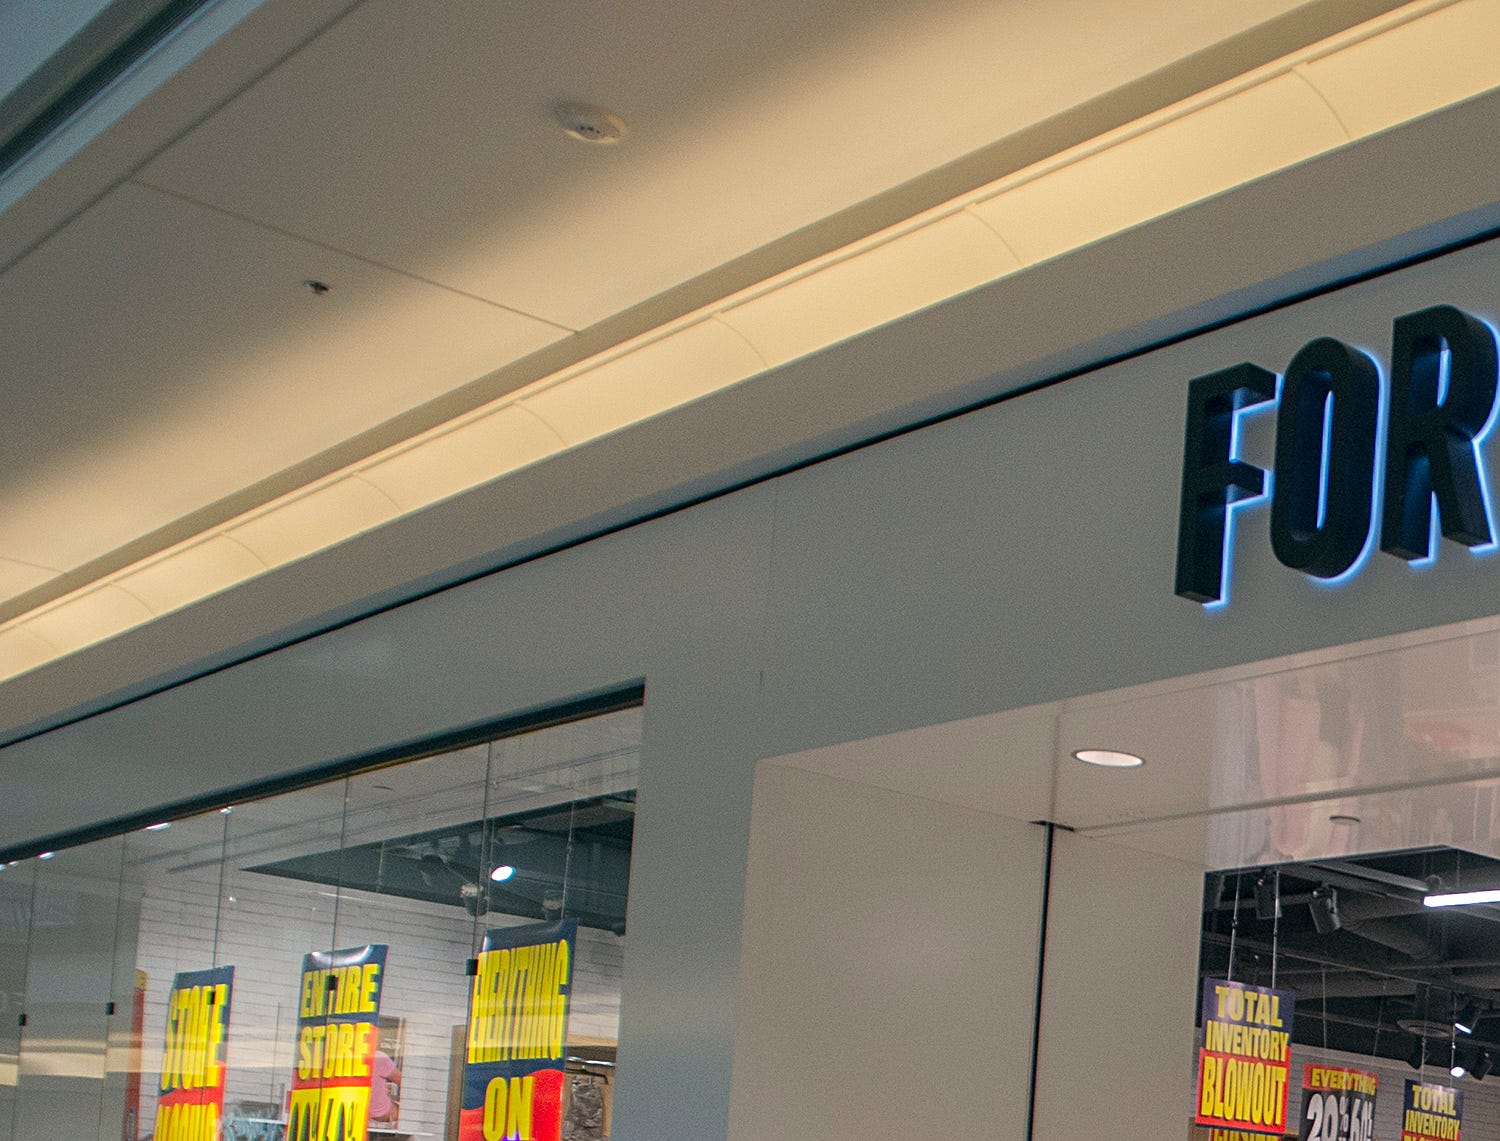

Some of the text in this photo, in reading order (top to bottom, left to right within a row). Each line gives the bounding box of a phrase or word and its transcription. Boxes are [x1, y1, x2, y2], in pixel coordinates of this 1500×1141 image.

[302, 963, 380, 1019] ENTIRE
[467, 938, 571, 1065] EVERYTHING
[1215, 985, 1283, 1028] TOTAL
[160, 983, 229, 1090] STORE
[298, 1021, 371, 1081] STORE
[1205, 1019, 1289, 1062] INVENTORY
[1201, 1055, 1287, 1126] BLOWOUT
[1411, 1084, 1457, 1117] TOTAL
[1405, 1109, 1460, 1141] INVENTORY
